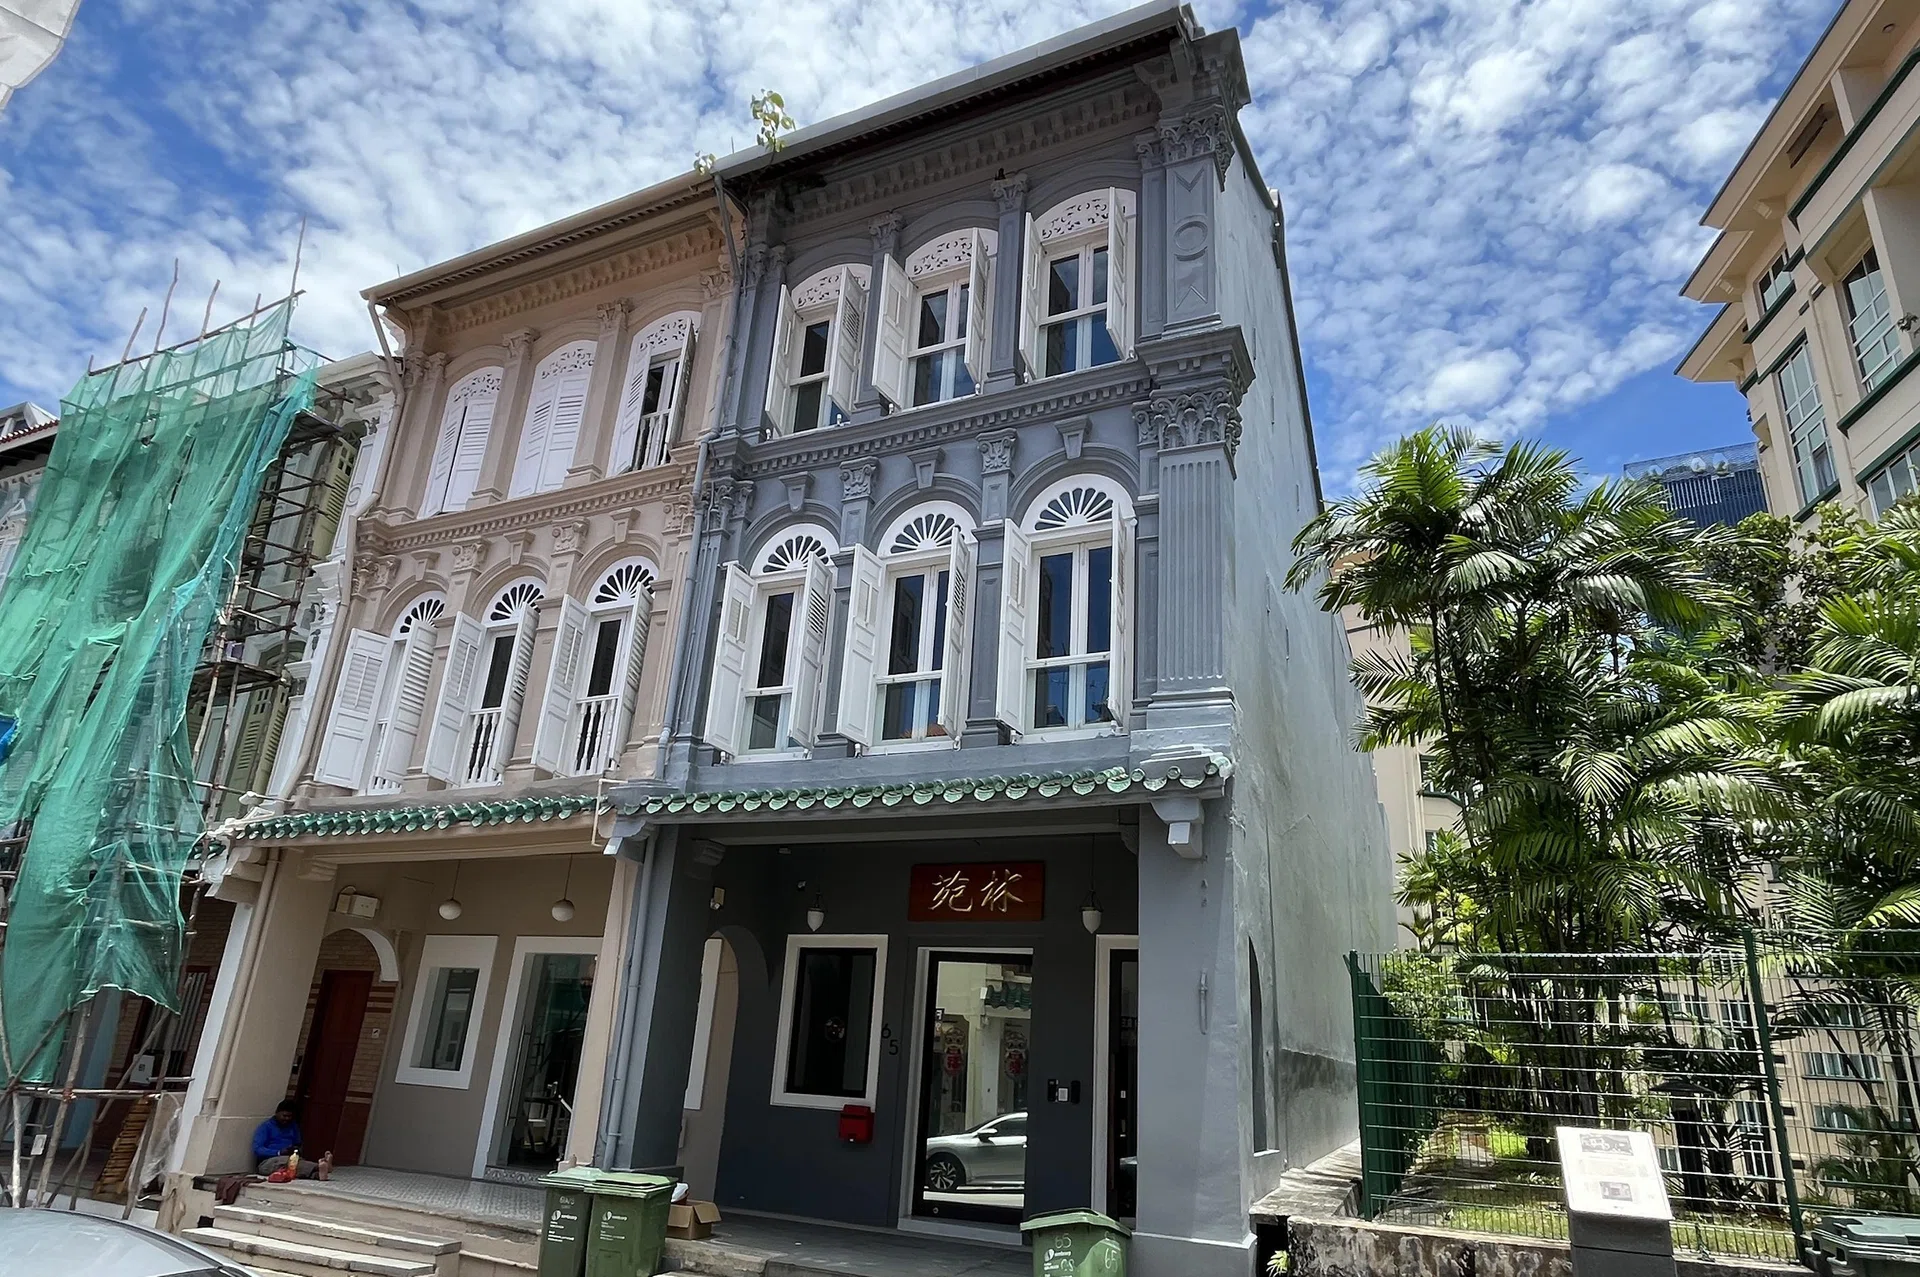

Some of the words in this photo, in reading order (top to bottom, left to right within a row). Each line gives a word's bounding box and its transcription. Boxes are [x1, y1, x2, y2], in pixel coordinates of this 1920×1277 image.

[881, 1023, 899, 1055] 65
[1055, 1232, 1072, 1249] 65
[1104, 1247, 1118, 1273] 65
